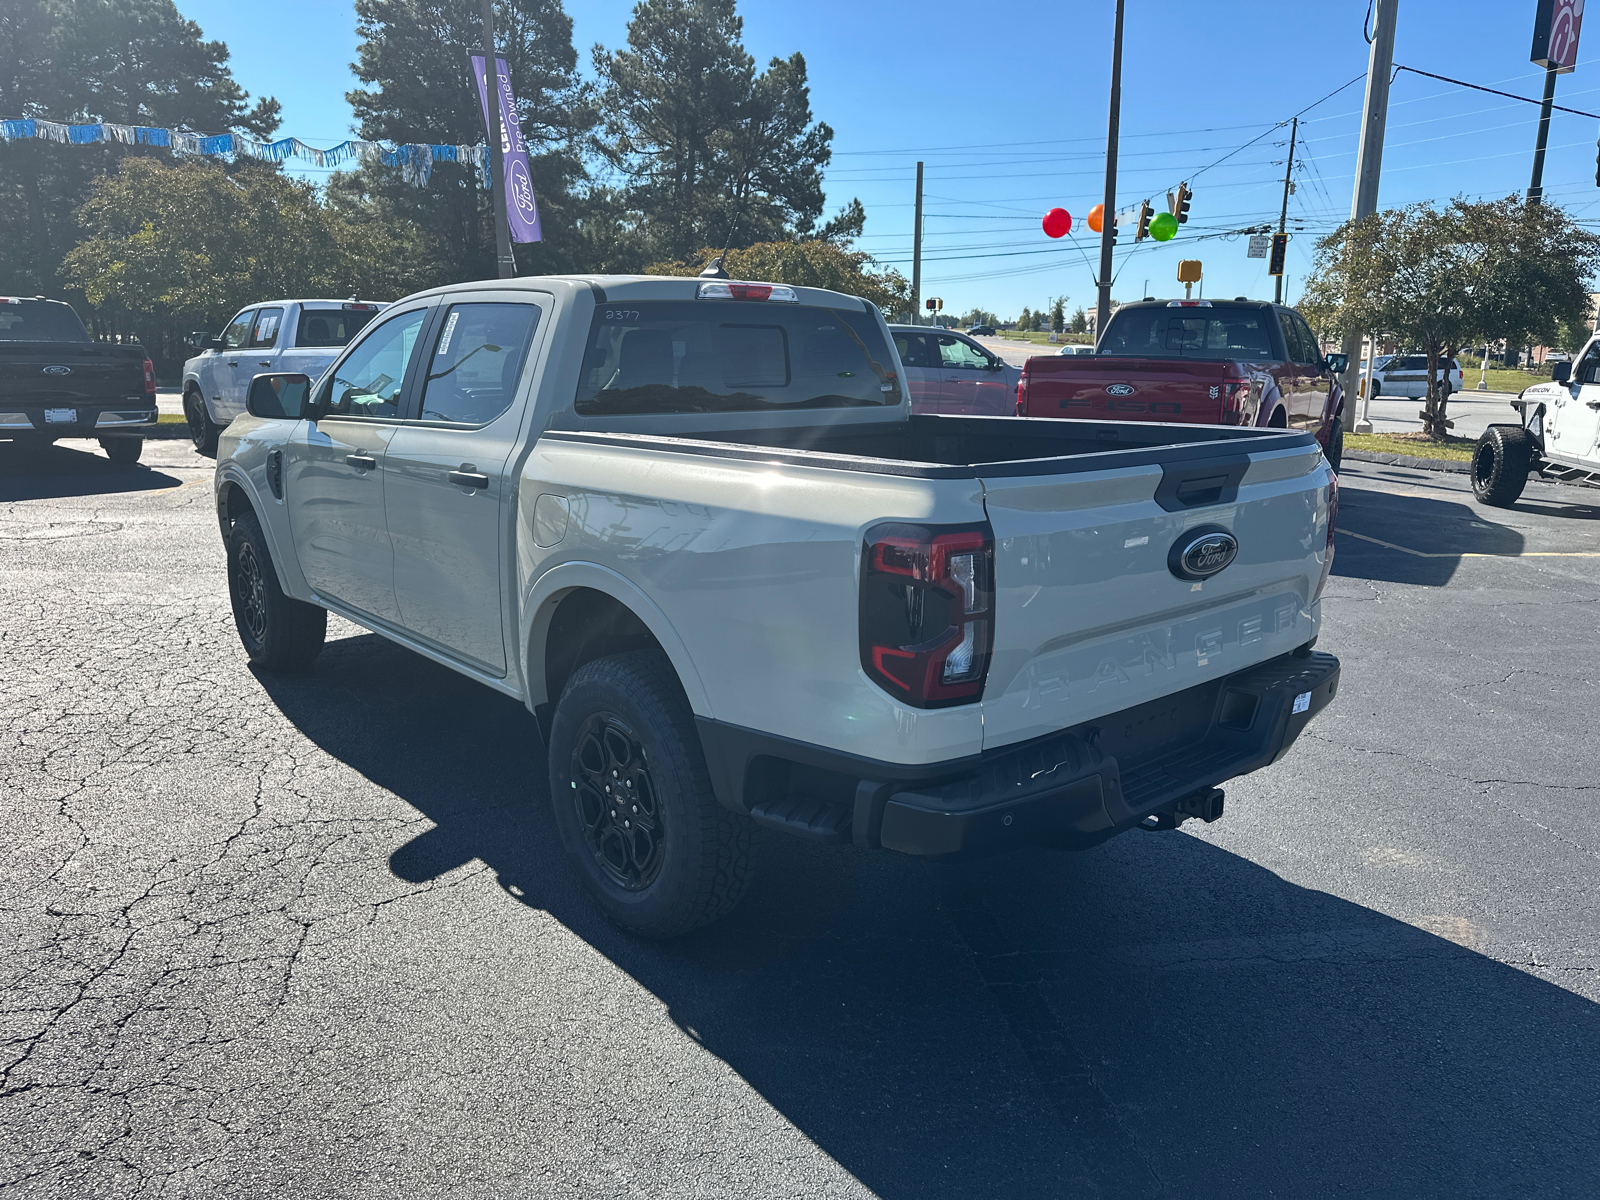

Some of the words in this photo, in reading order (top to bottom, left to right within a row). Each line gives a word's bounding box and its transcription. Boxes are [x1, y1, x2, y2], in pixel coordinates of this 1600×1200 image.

[496, 74, 526, 153] Pre-Owned
[516, 174, 533, 212] Ford
[605, 310, 640, 322] 2377
[1110, 385, 1130, 395] Ford
[1059, 398, 1182, 415] F-150
[1197, 541, 1227, 567] Ford
[1030, 600, 1298, 711] RANGER
